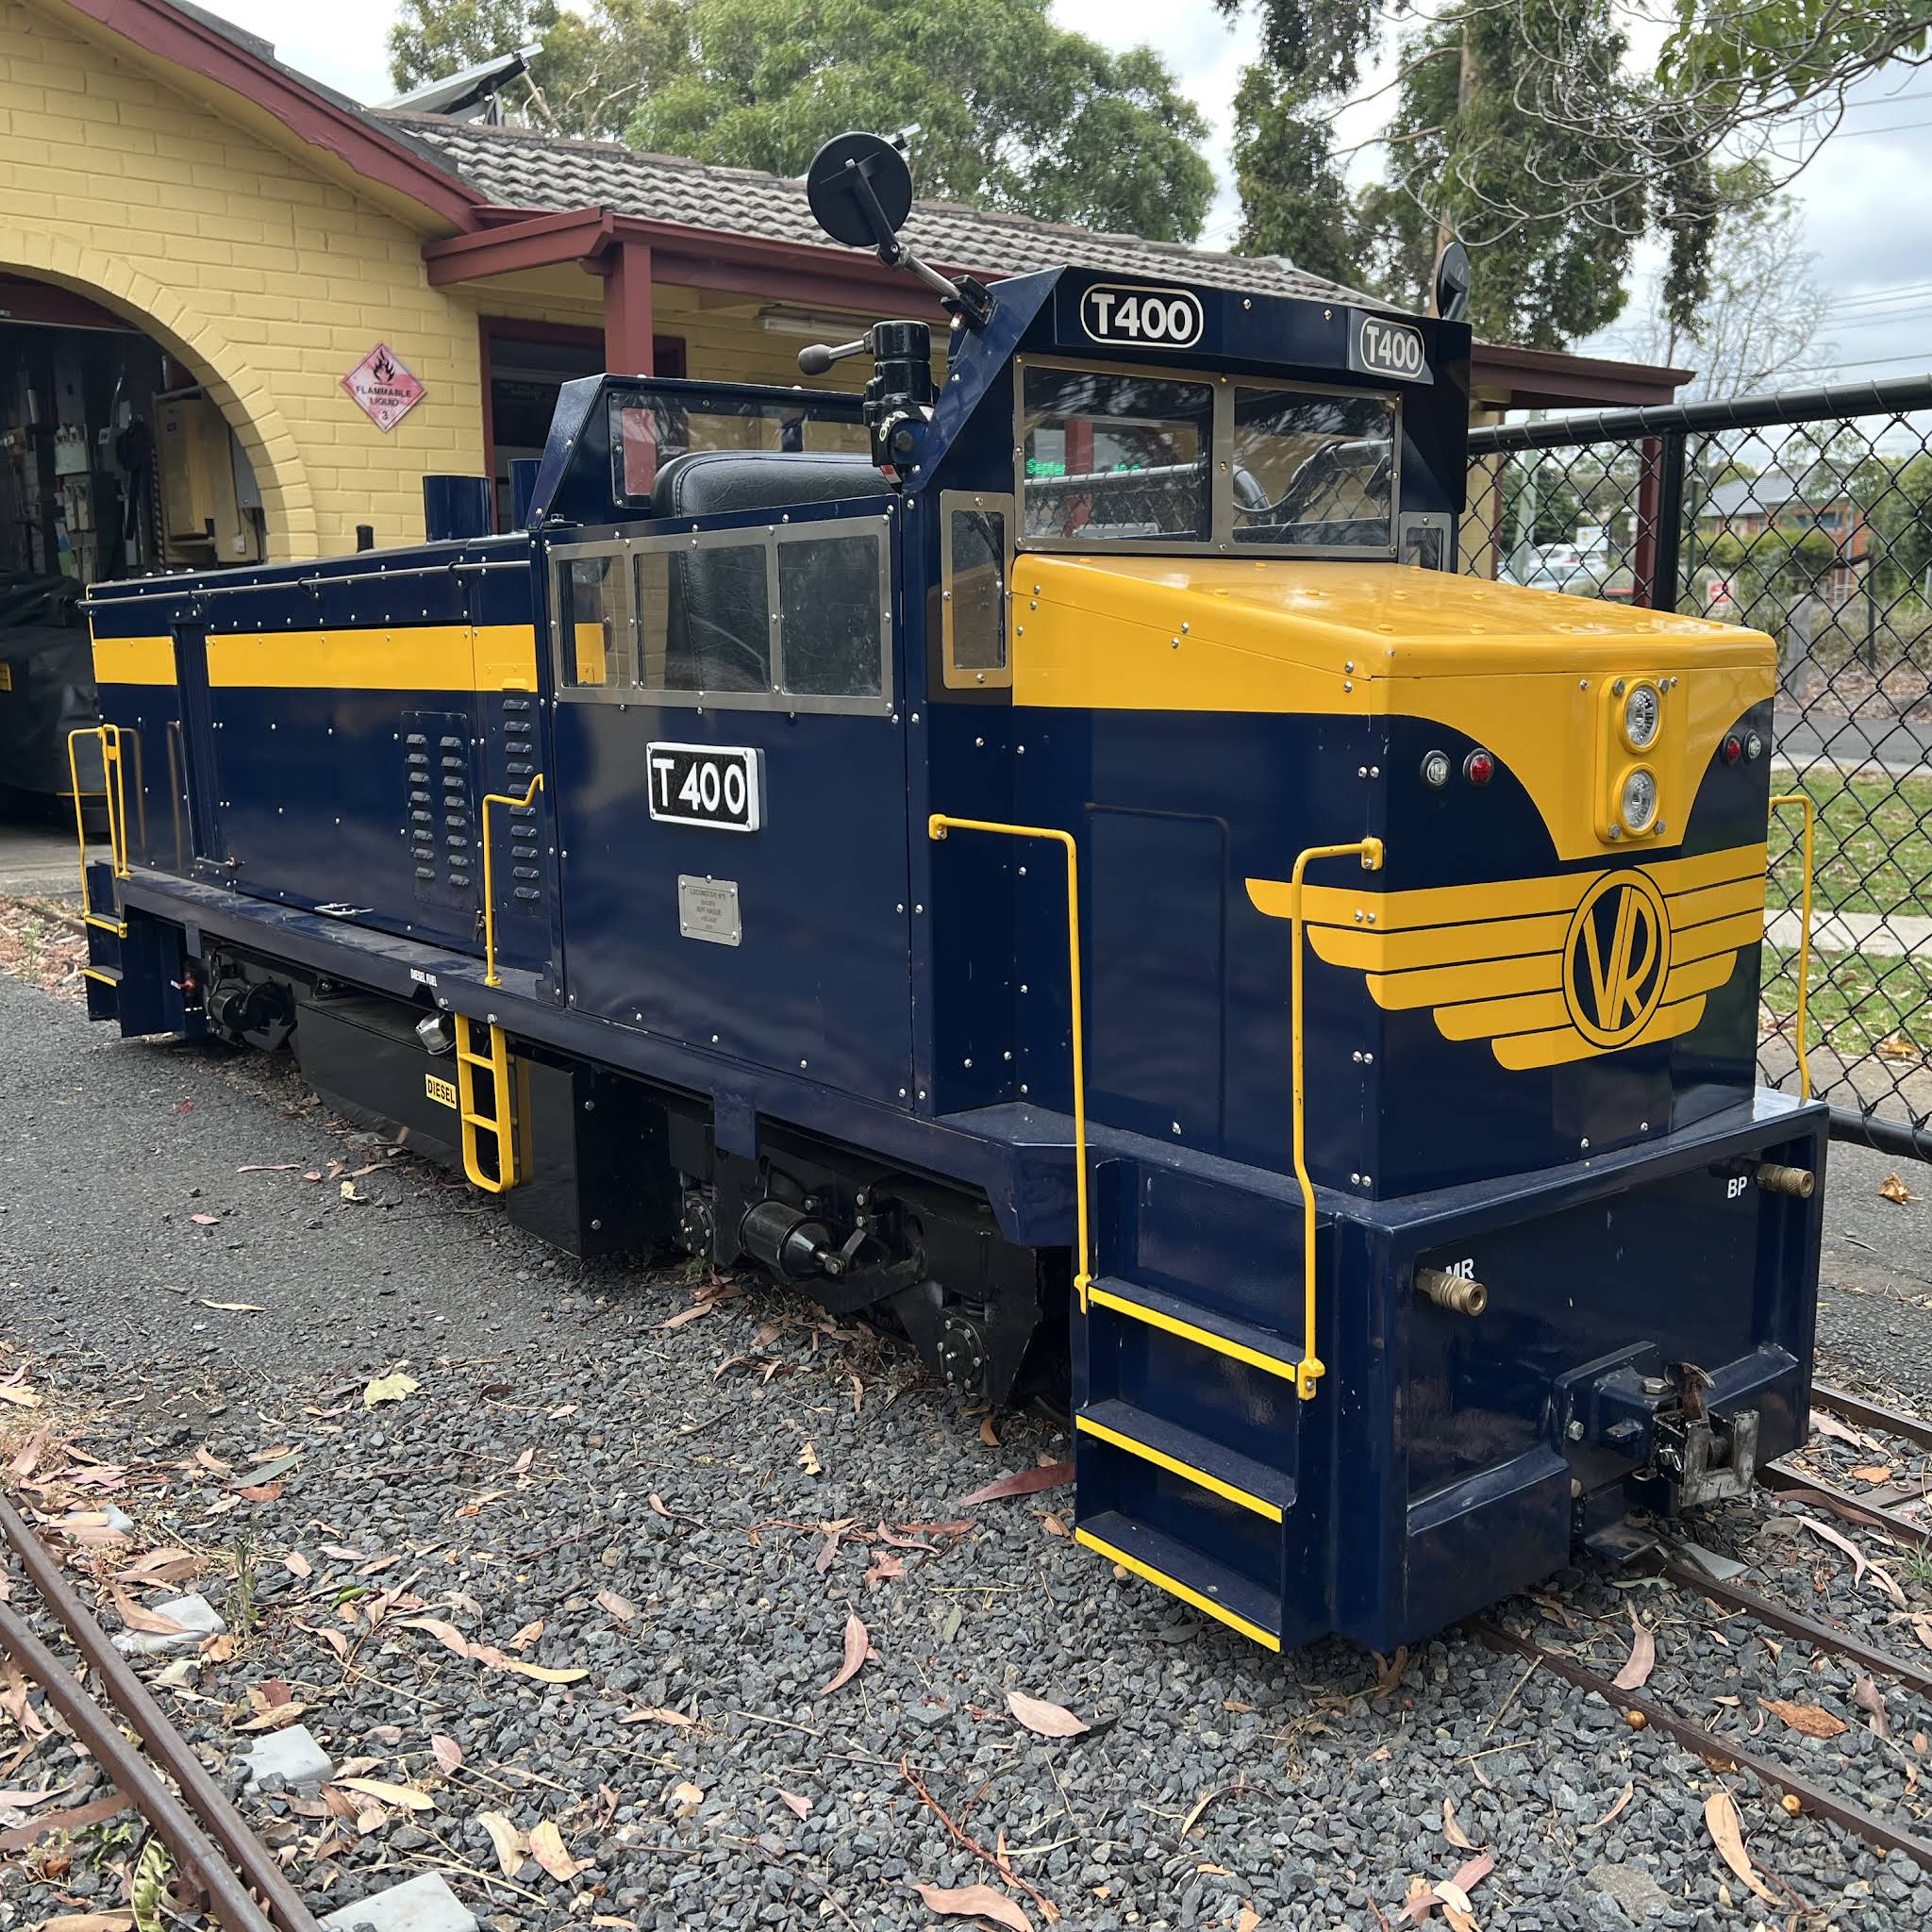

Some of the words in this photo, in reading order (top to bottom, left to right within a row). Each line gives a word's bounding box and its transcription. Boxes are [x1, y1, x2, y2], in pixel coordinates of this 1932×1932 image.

[1091, 292, 1192, 341] T400
[1366, 325, 1418, 371] T400
[356, 386, 412, 398] FLAMMABLE
[370, 397, 399, 408] LIQUID
[381, 410, 389, 421] 3
[652, 758, 675, 807] T
[678, 761, 746, 815] 400
[1583, 886, 1657, 1031] VR
[409, 968, 426, 984] DIESEL
[425, 973, 438, 988] FUEL
[427, 1078, 455, 1105] DIESEL
[1727, 1175, 1747, 1199] BP
[1445, 1257, 1474, 1279] MR
